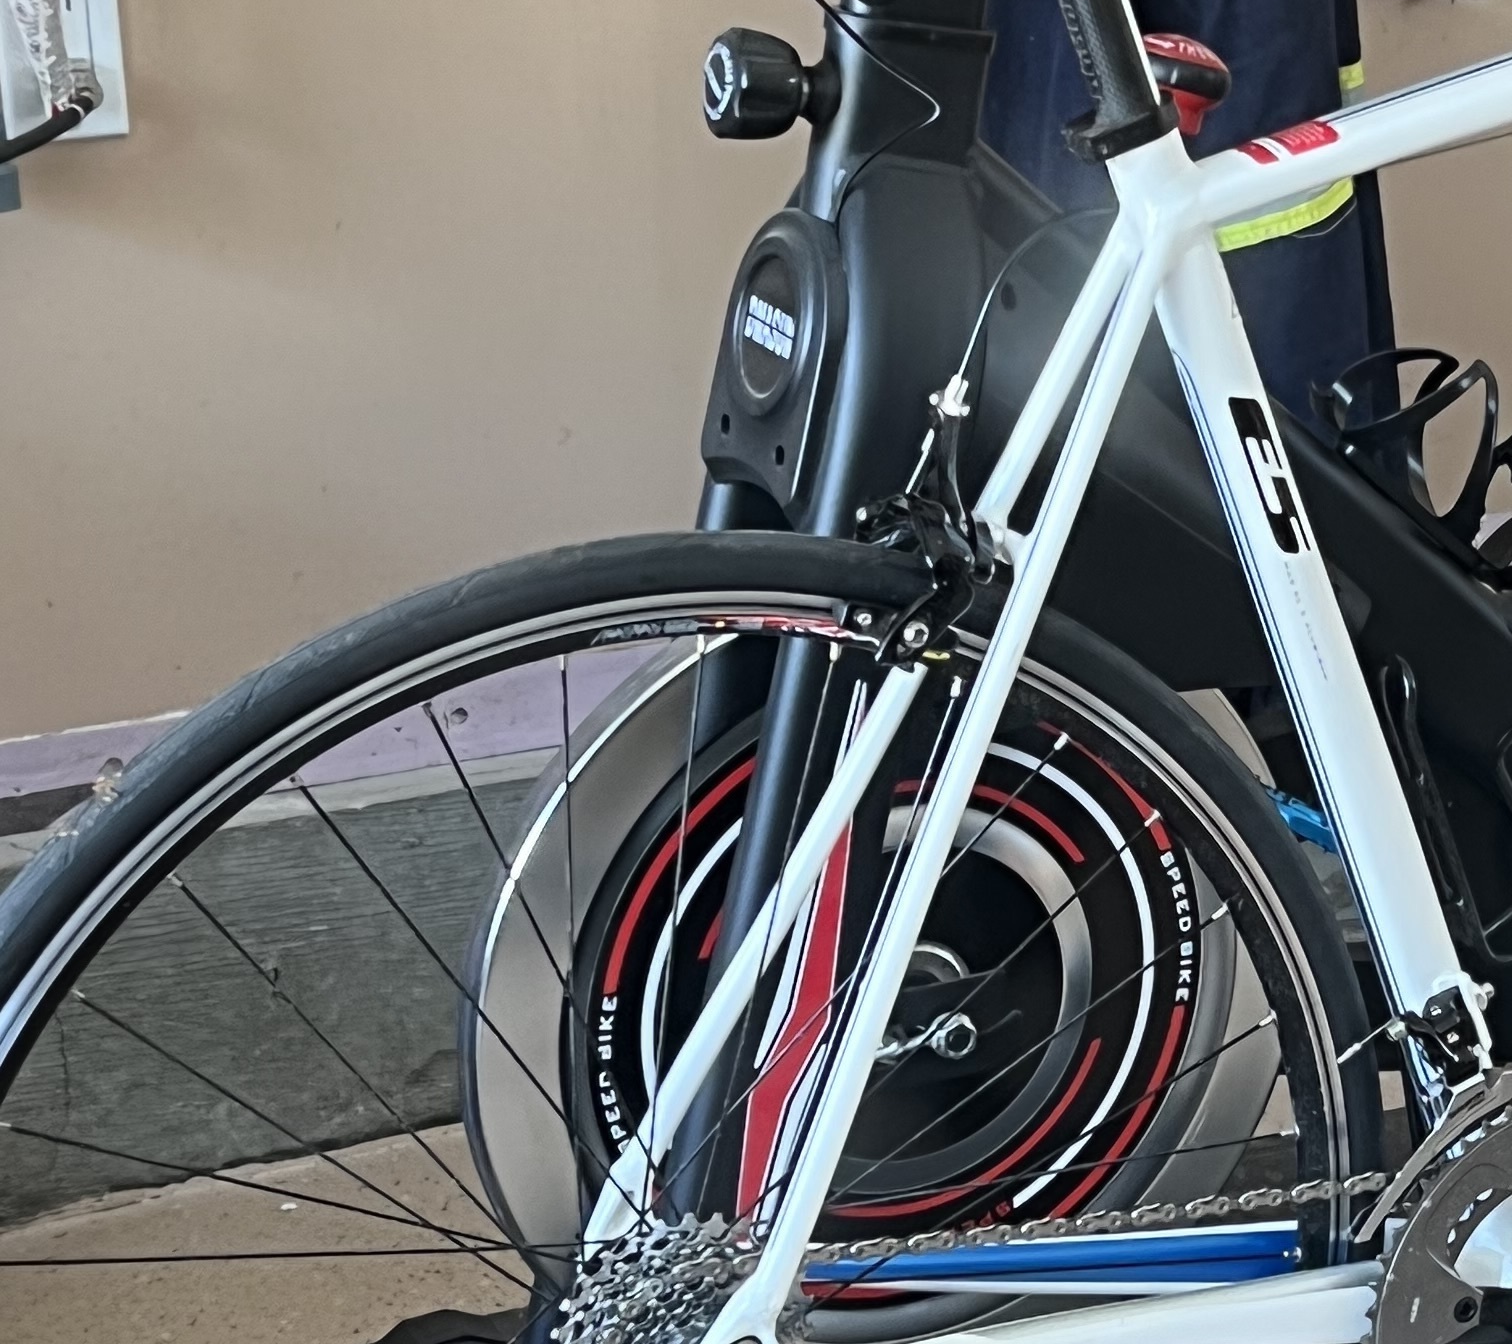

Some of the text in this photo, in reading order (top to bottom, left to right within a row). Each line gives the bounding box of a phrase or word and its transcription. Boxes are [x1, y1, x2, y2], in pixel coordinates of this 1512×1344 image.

[1228, 396, 1311, 555] E5
[1158, 849, 1196, 1004] SPEED BIKE
[599, 994, 618, 1060] BIKE
